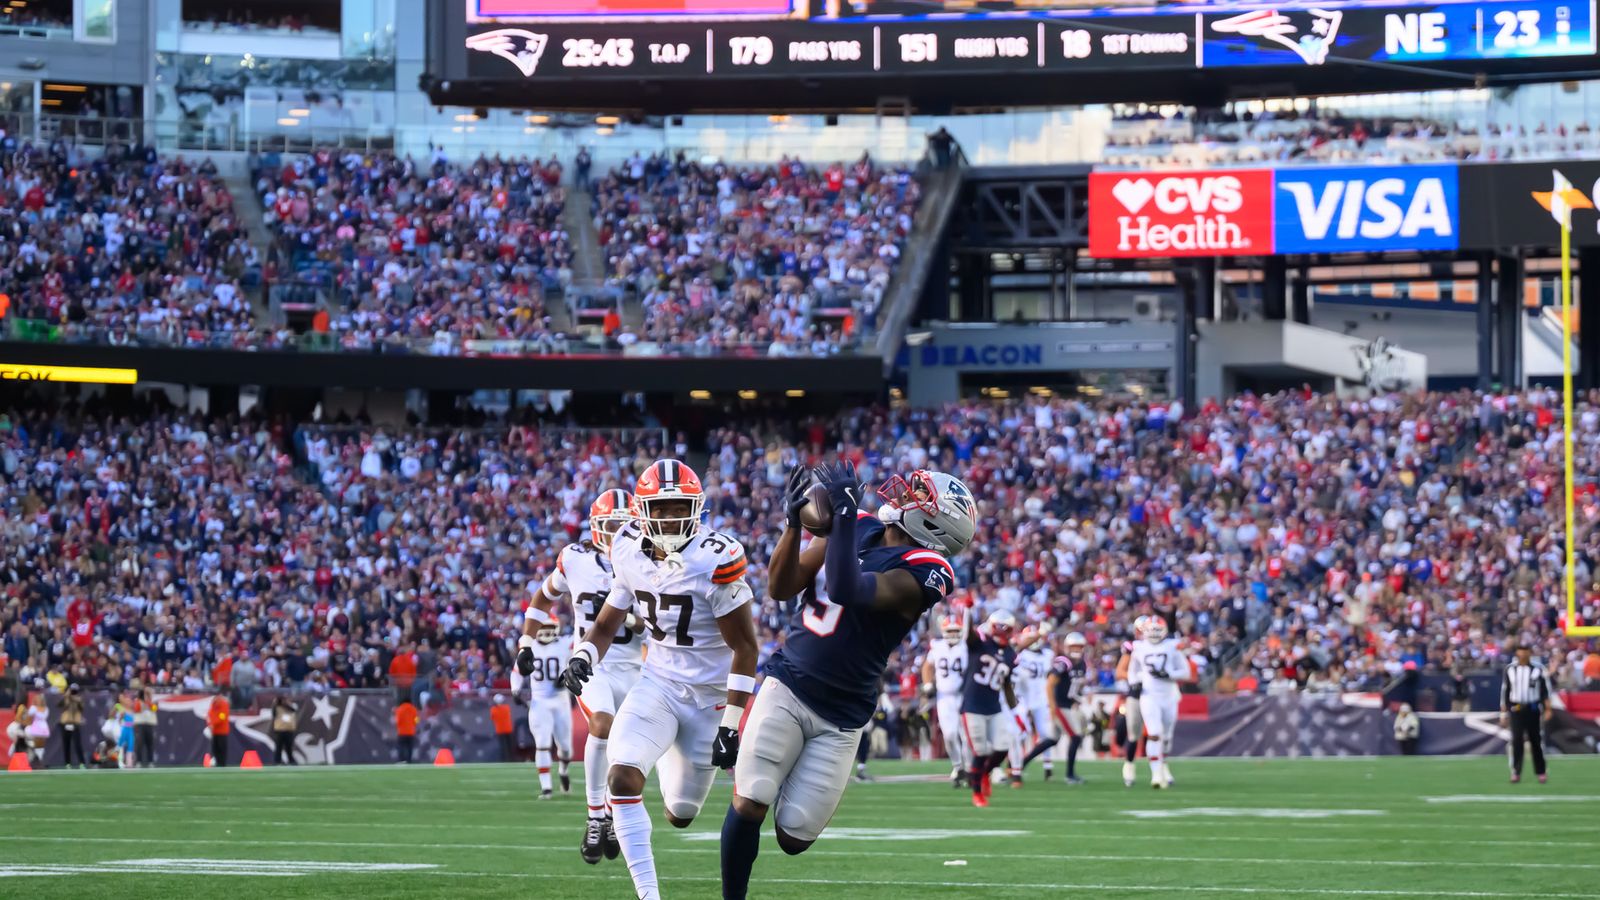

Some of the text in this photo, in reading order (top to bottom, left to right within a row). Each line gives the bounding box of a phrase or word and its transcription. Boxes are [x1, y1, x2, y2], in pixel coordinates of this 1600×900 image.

[1385, 13, 1446, 54] NE
[1494, 11, 1540, 47] 23
[562, 38, 634, 67] 25:43
[728, 37, 773, 65] 179
[898, 34, 938, 62] 151
[1154, 175, 1243, 214] CVS
[1279, 178, 1452, 239] VISA
[1117, 214, 1242, 250] Health
[938, 657, 963, 678] 94
